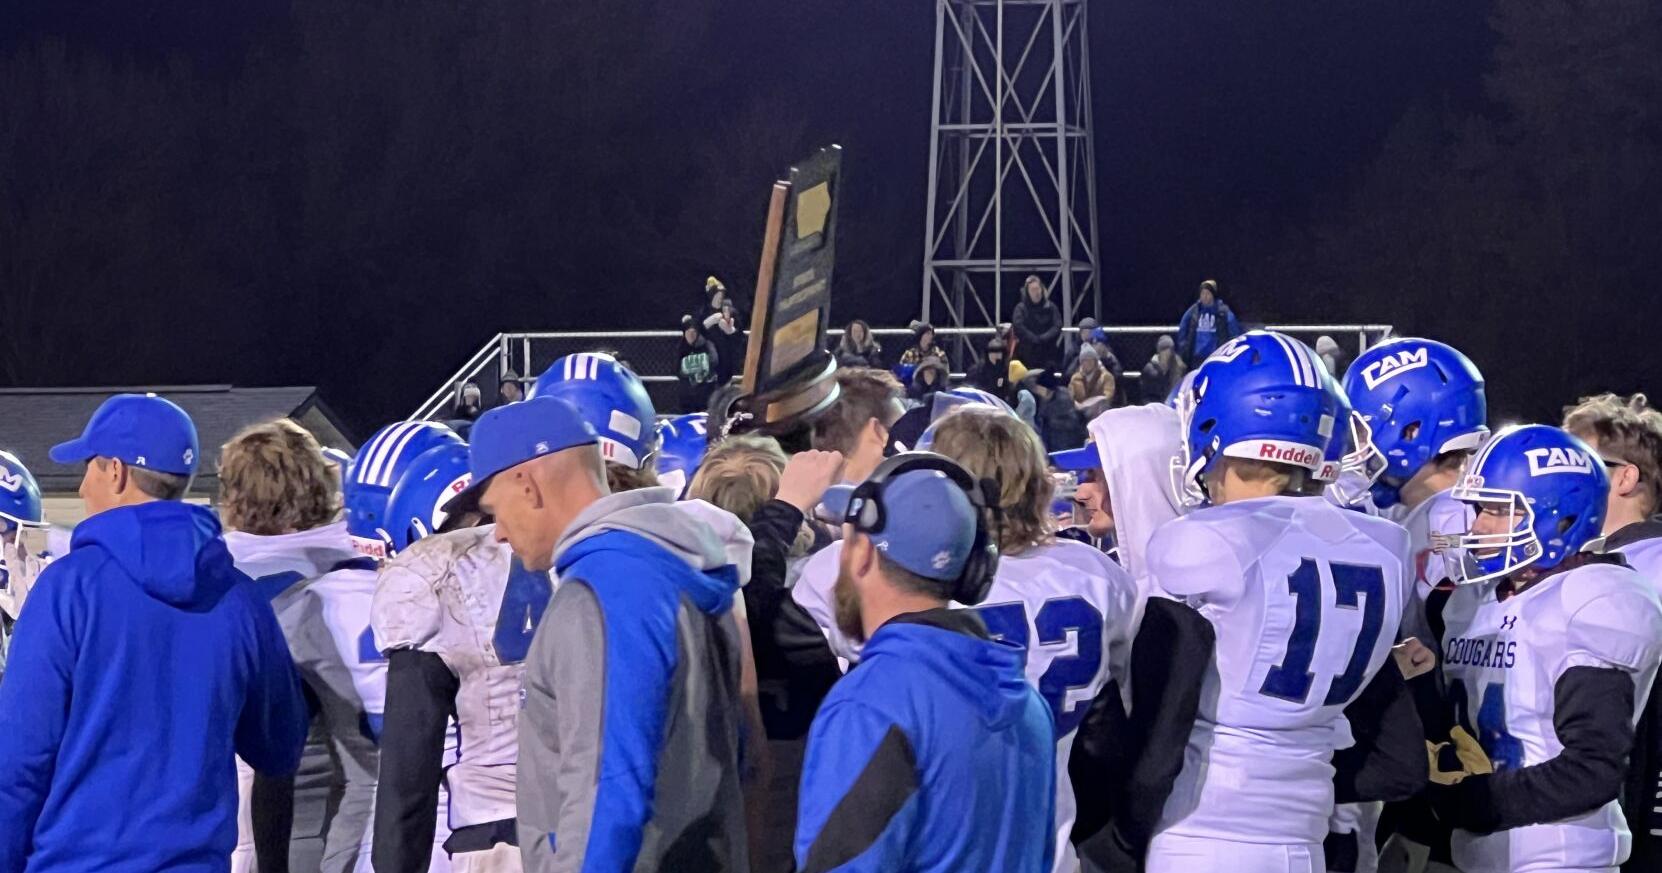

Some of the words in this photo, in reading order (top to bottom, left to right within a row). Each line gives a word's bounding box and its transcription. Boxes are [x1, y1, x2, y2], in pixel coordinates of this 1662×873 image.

[1360, 347, 1428, 391] CAM
[1523, 447, 1592, 477] CAM
[1258, 556, 1386, 707] 17
[1445, 636, 1517, 669] COUGARS
